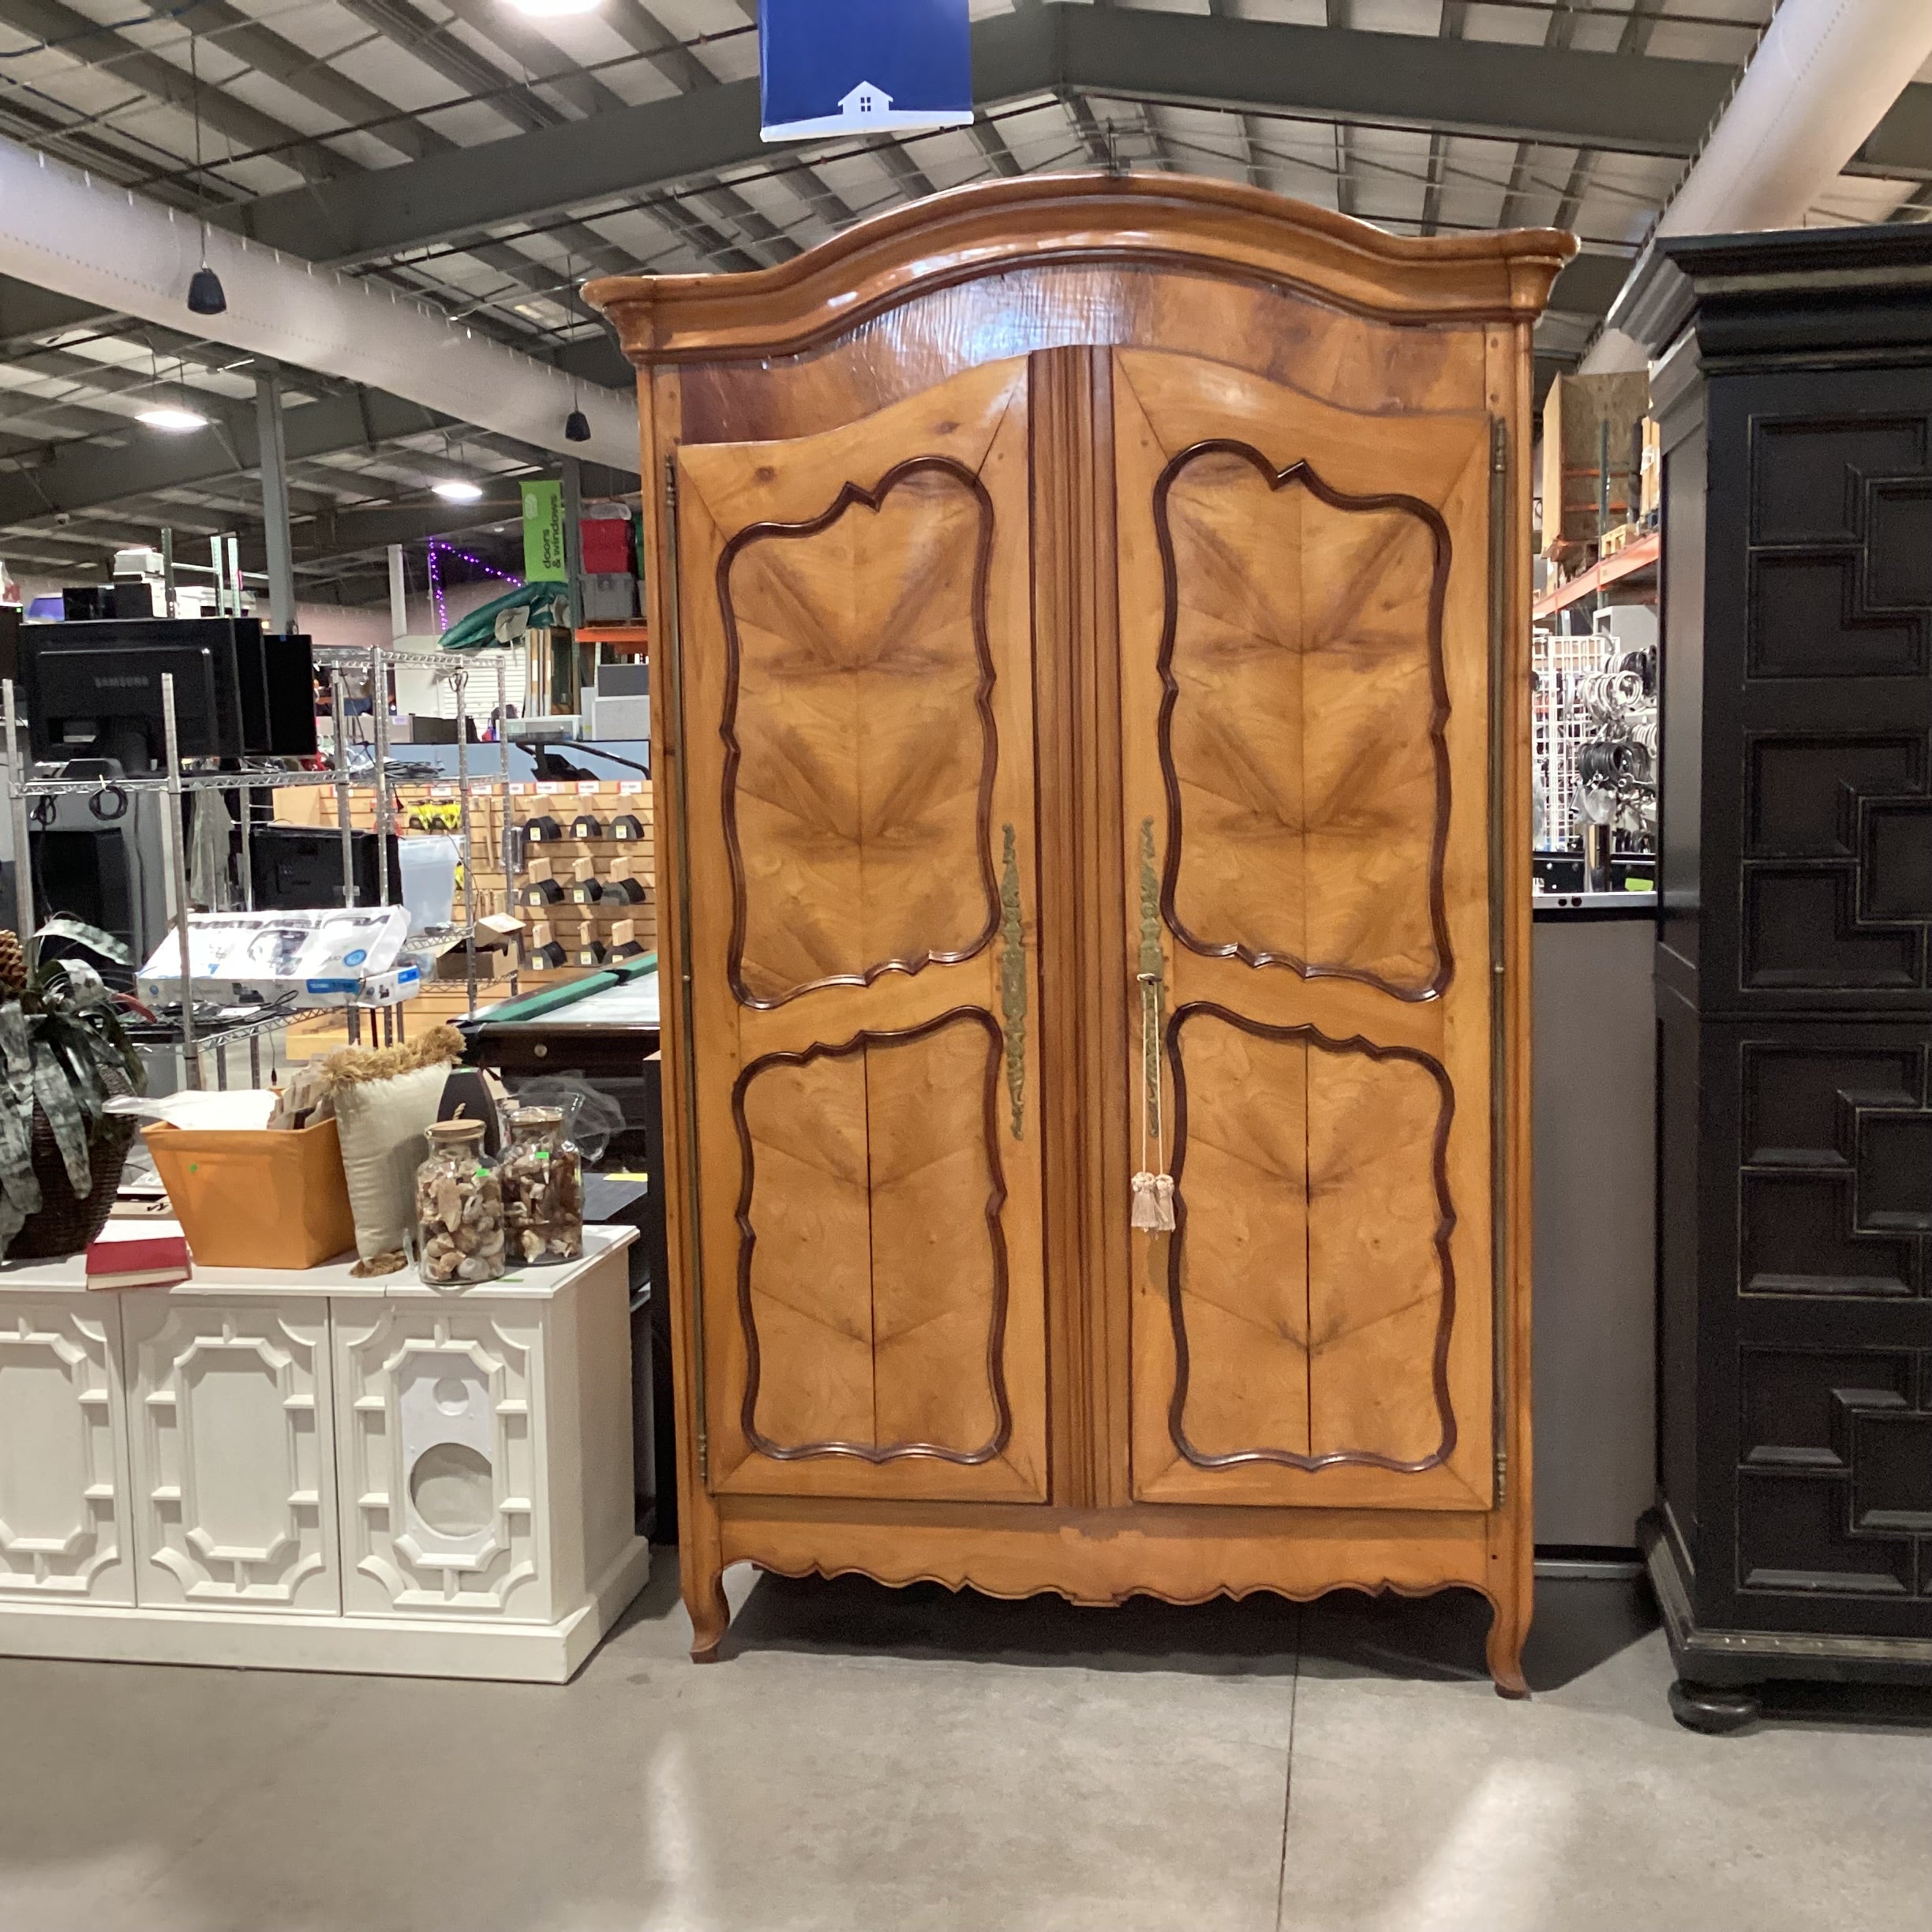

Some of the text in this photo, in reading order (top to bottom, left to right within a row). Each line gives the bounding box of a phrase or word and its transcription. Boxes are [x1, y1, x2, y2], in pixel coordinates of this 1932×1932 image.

[542, 529, 552, 569] doors
[550, 494, 561, 569] & windows
